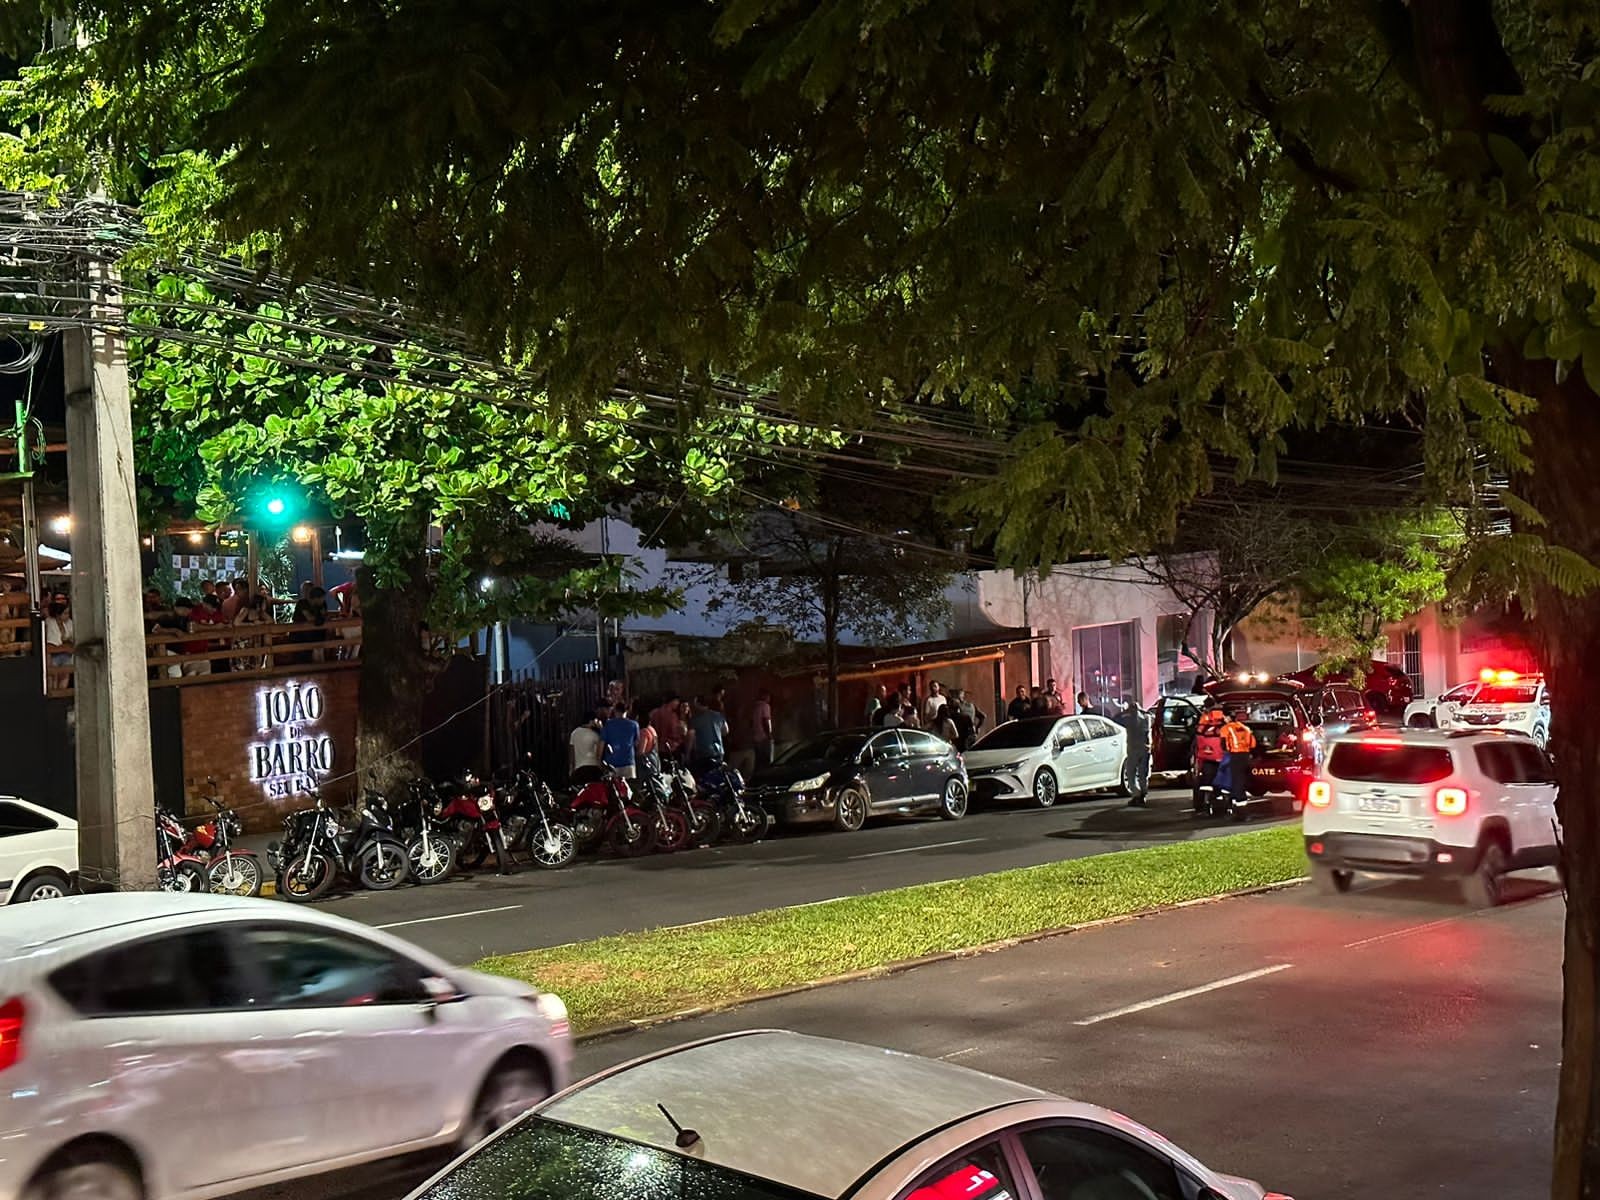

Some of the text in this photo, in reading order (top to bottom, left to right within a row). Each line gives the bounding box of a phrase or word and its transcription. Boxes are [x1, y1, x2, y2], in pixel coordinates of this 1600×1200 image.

[262, 683, 323, 730] JOÃO
[289, 726, 303, 738] DE
[254, 737, 335, 779] BARRO
